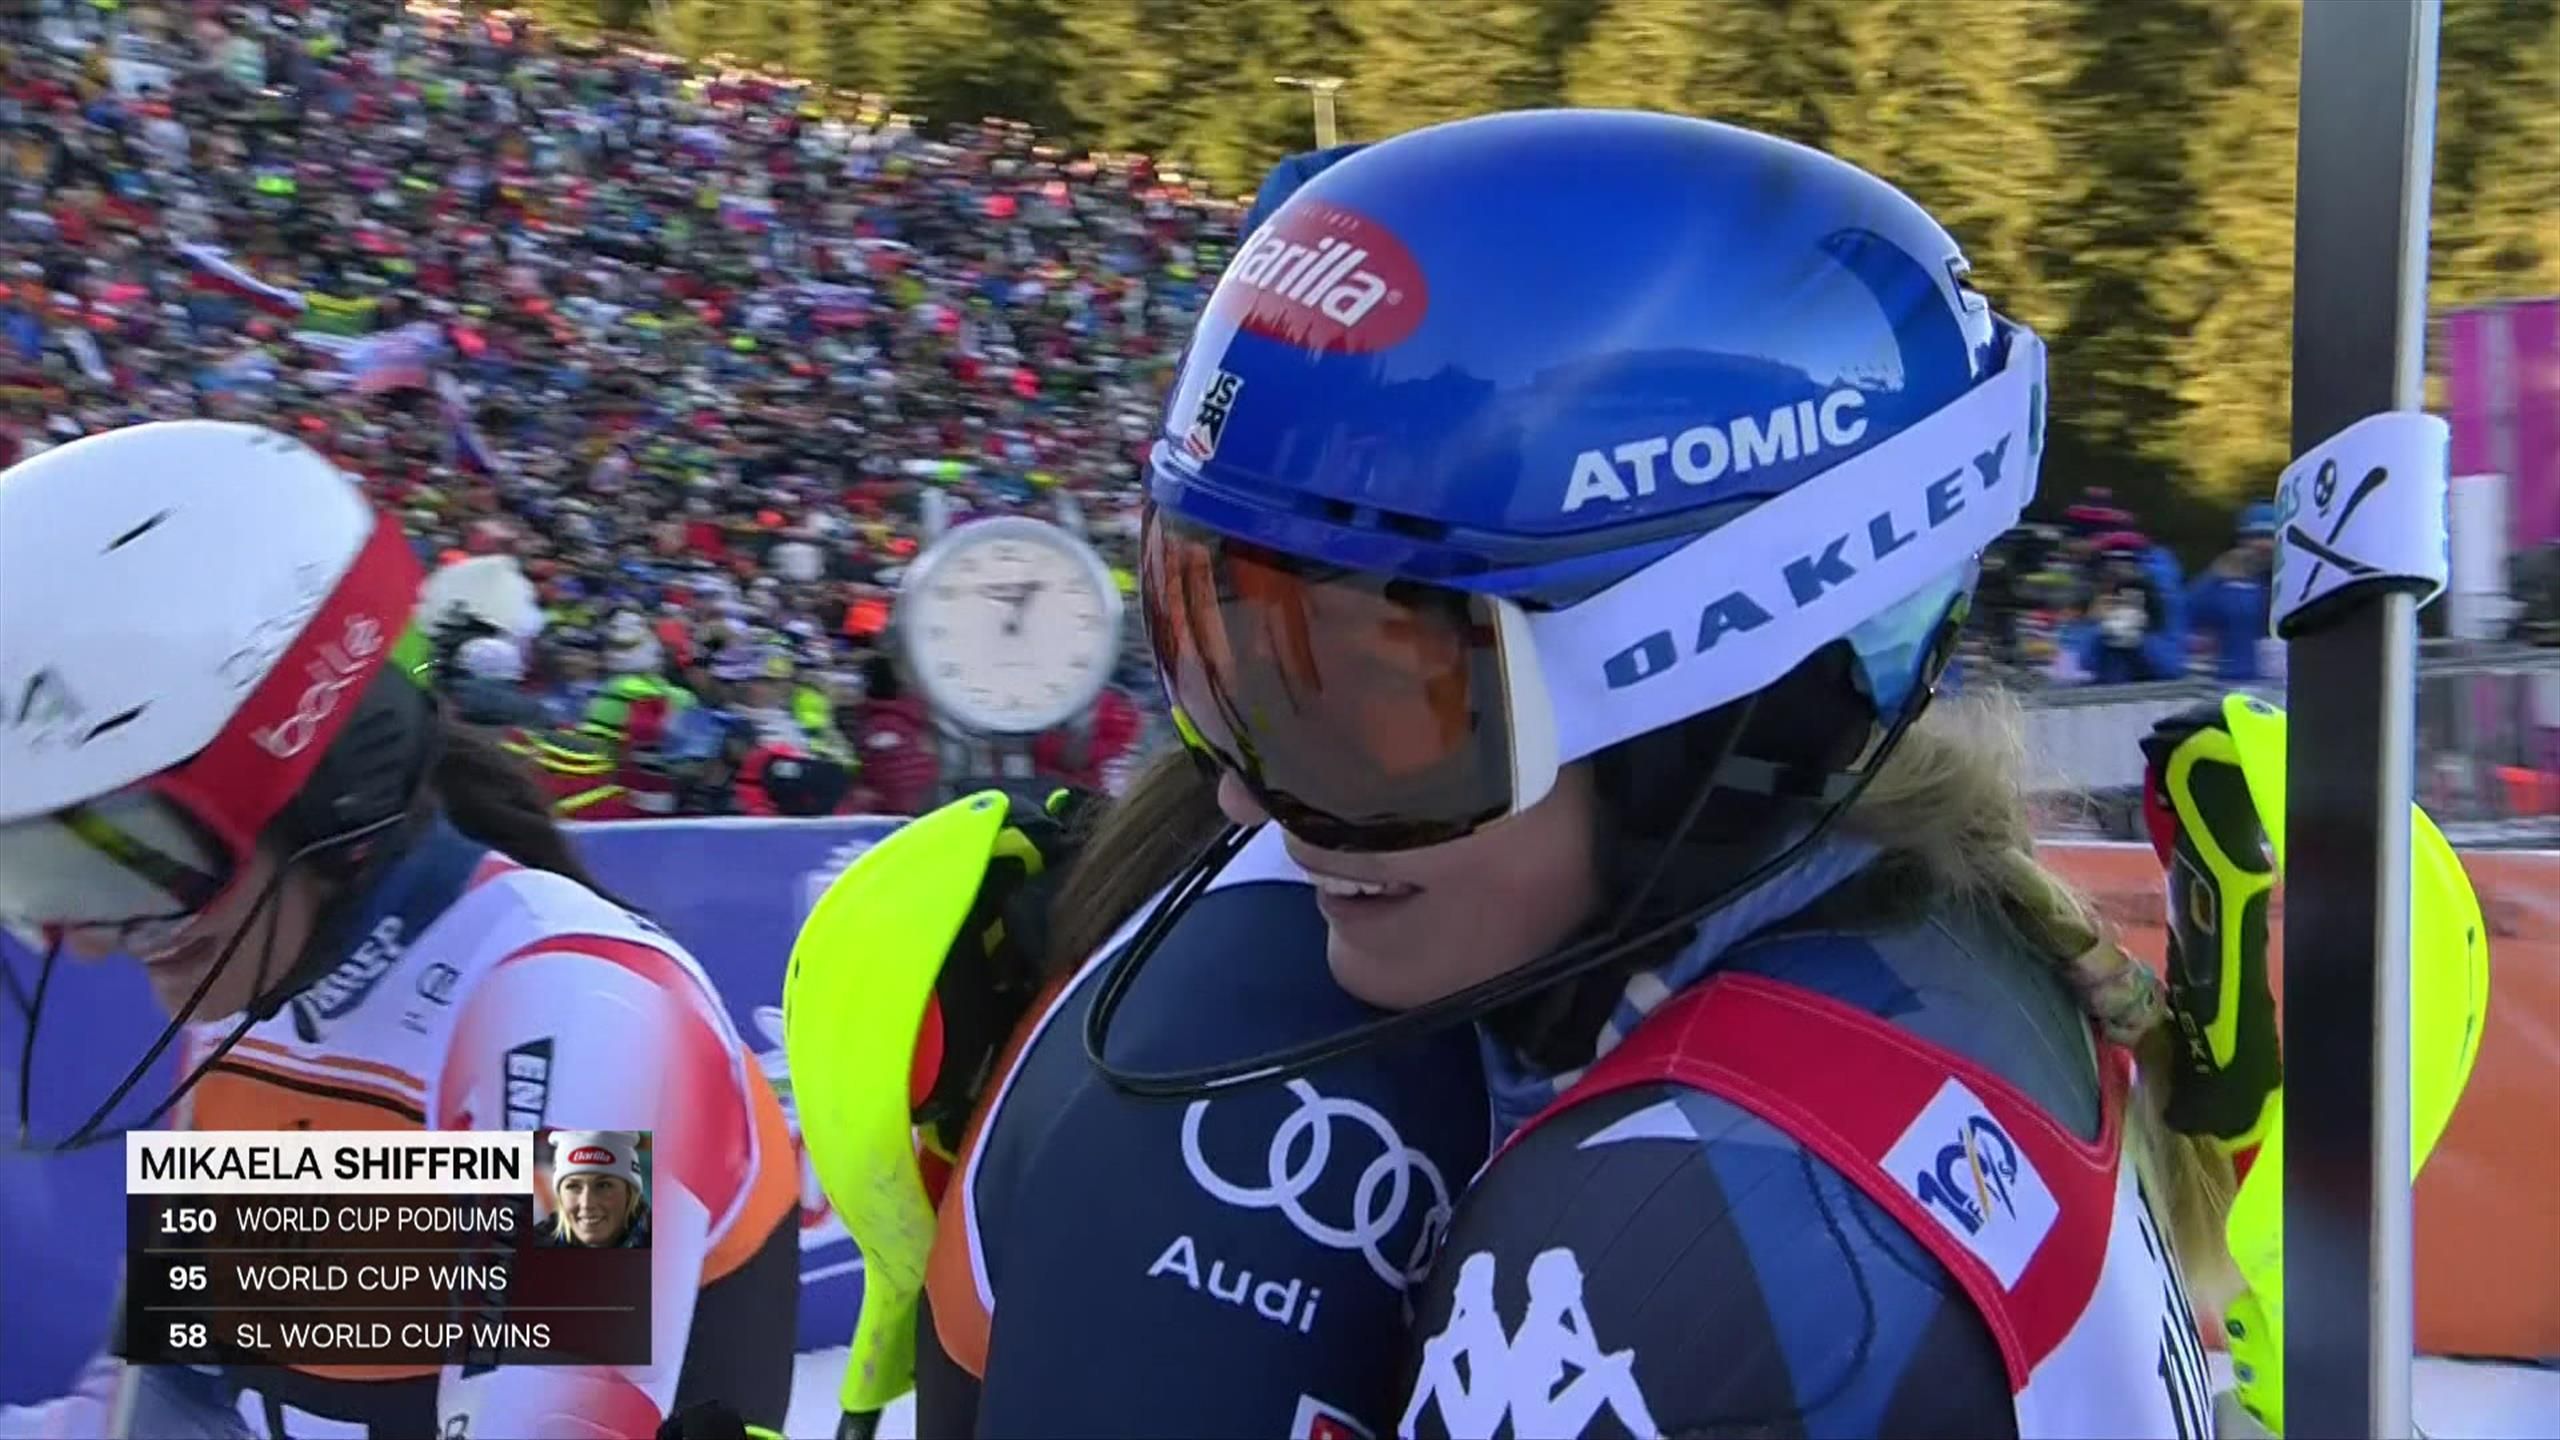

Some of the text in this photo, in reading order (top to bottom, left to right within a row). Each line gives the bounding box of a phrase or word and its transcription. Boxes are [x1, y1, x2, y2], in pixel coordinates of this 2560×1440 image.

[1561, 388, 1869, 513] ATOMIC
[1602, 431, 2012, 690] OAKLEY
[1147, 1235, 1322, 1333] Audi
